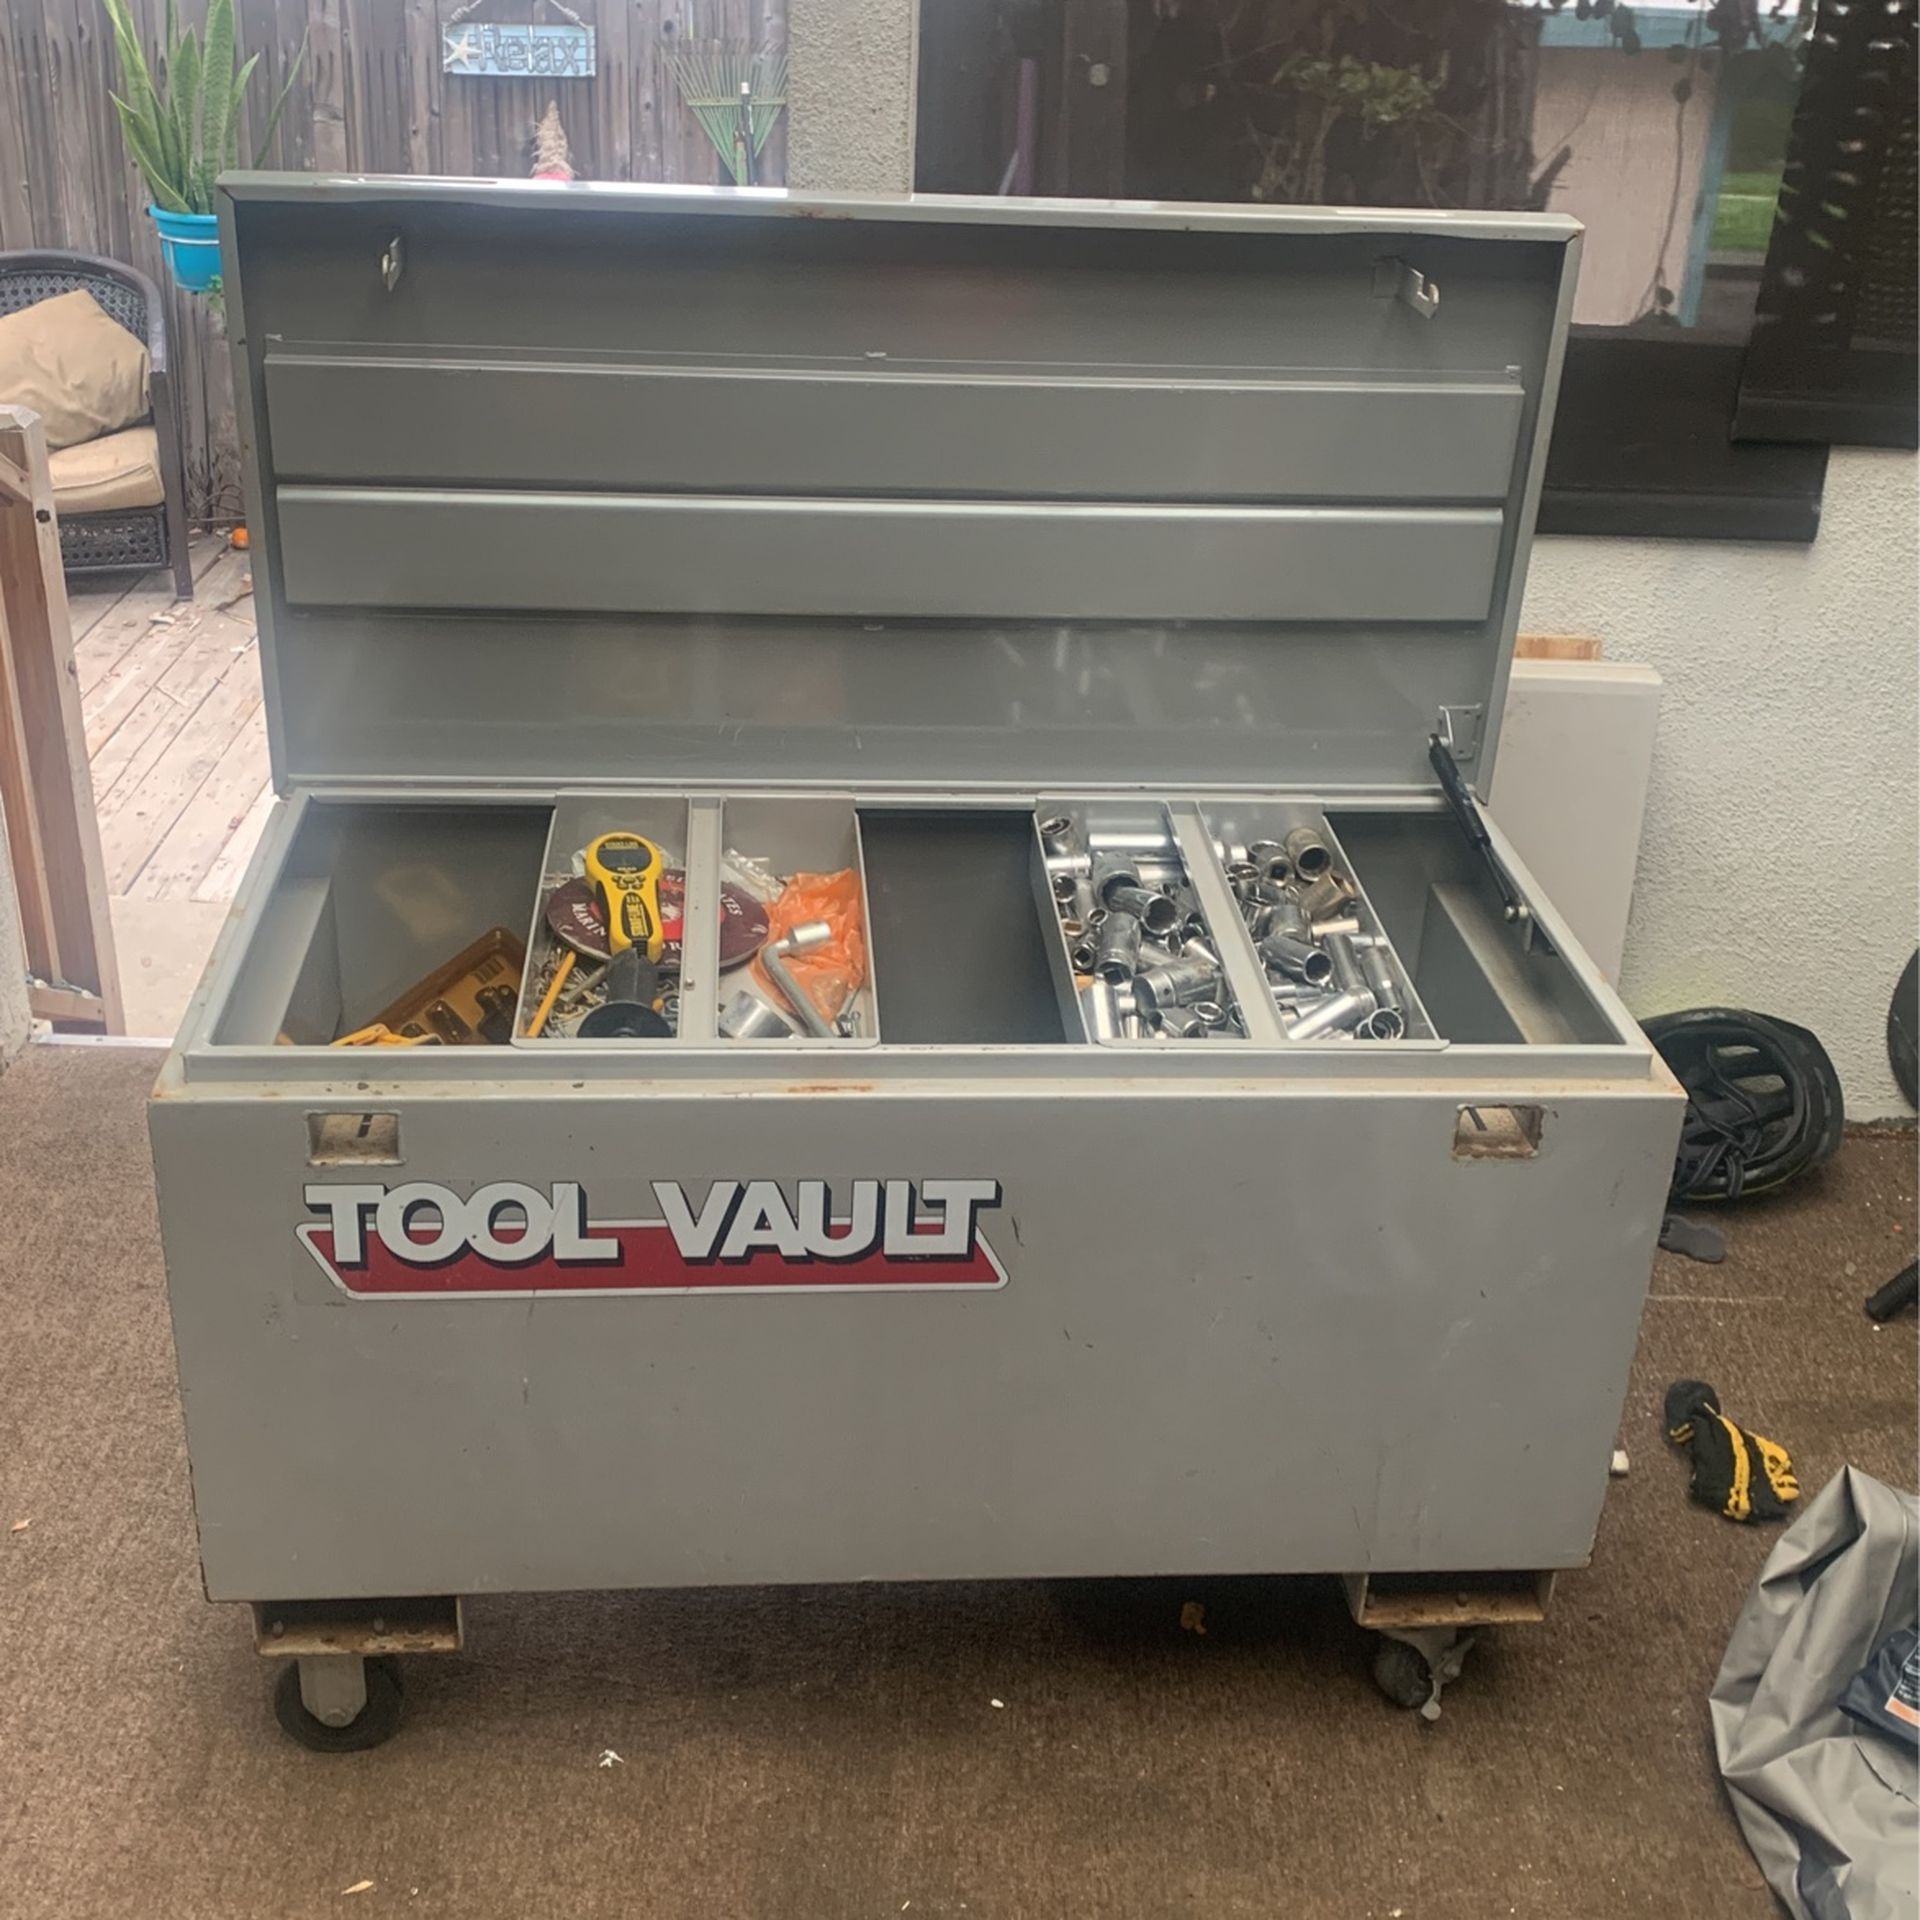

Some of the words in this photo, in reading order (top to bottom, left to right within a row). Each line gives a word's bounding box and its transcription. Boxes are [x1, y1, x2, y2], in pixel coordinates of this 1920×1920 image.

[475, 23, 580, 74] Relax
[303, 1181, 624, 1268] TOOL
[650, 1179, 1003, 1265] VAULT
